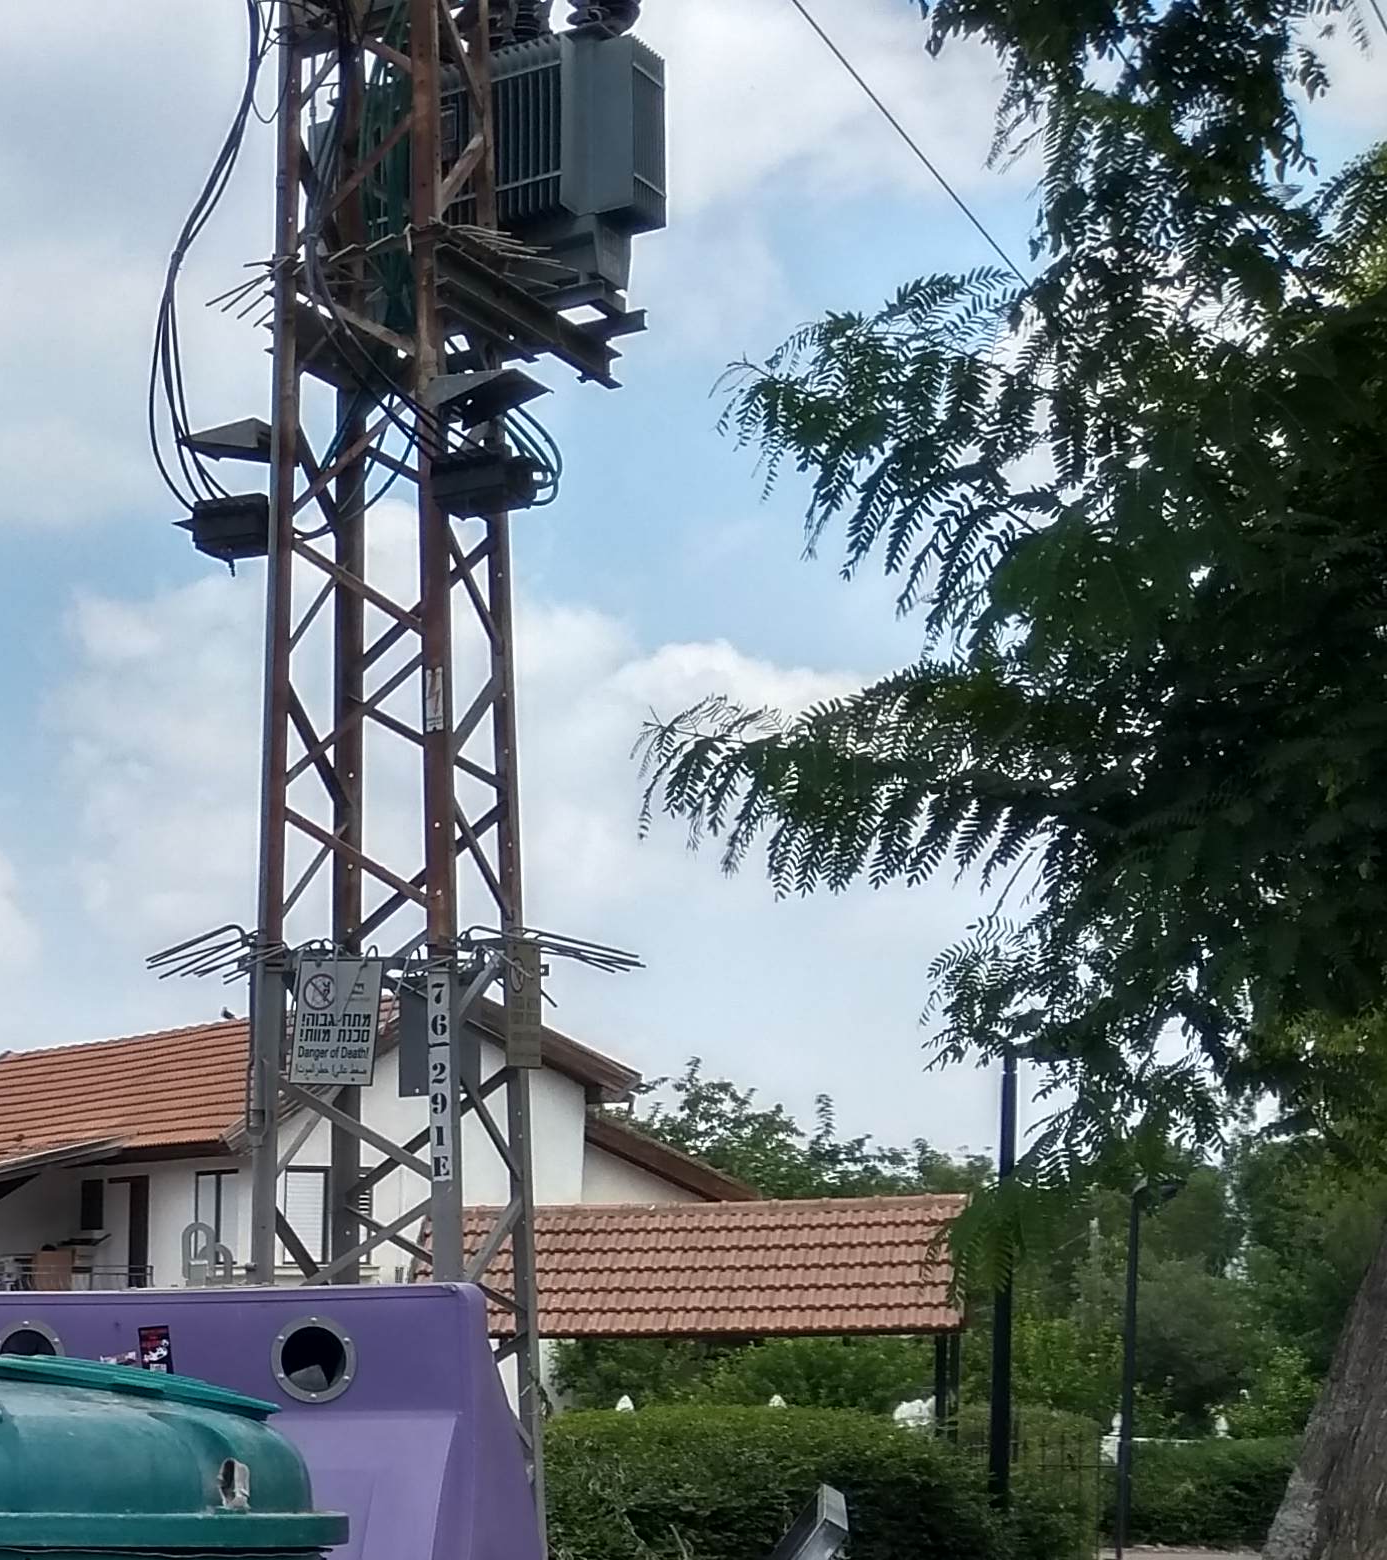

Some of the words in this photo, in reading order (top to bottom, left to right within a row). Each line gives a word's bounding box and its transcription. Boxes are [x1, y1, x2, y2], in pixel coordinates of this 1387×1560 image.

[301, 1013, 336, 1027] גבוה!
[342, 1013, 371, 1027] מתח
[299, 1029, 331, 1043] מוות!
[337, 1029, 370, 1043] סכנת
[298, 1045, 329, 1060] Danger
[330, 1045, 340, 1058] of
[341, 1046, 369, 1059] Death!
